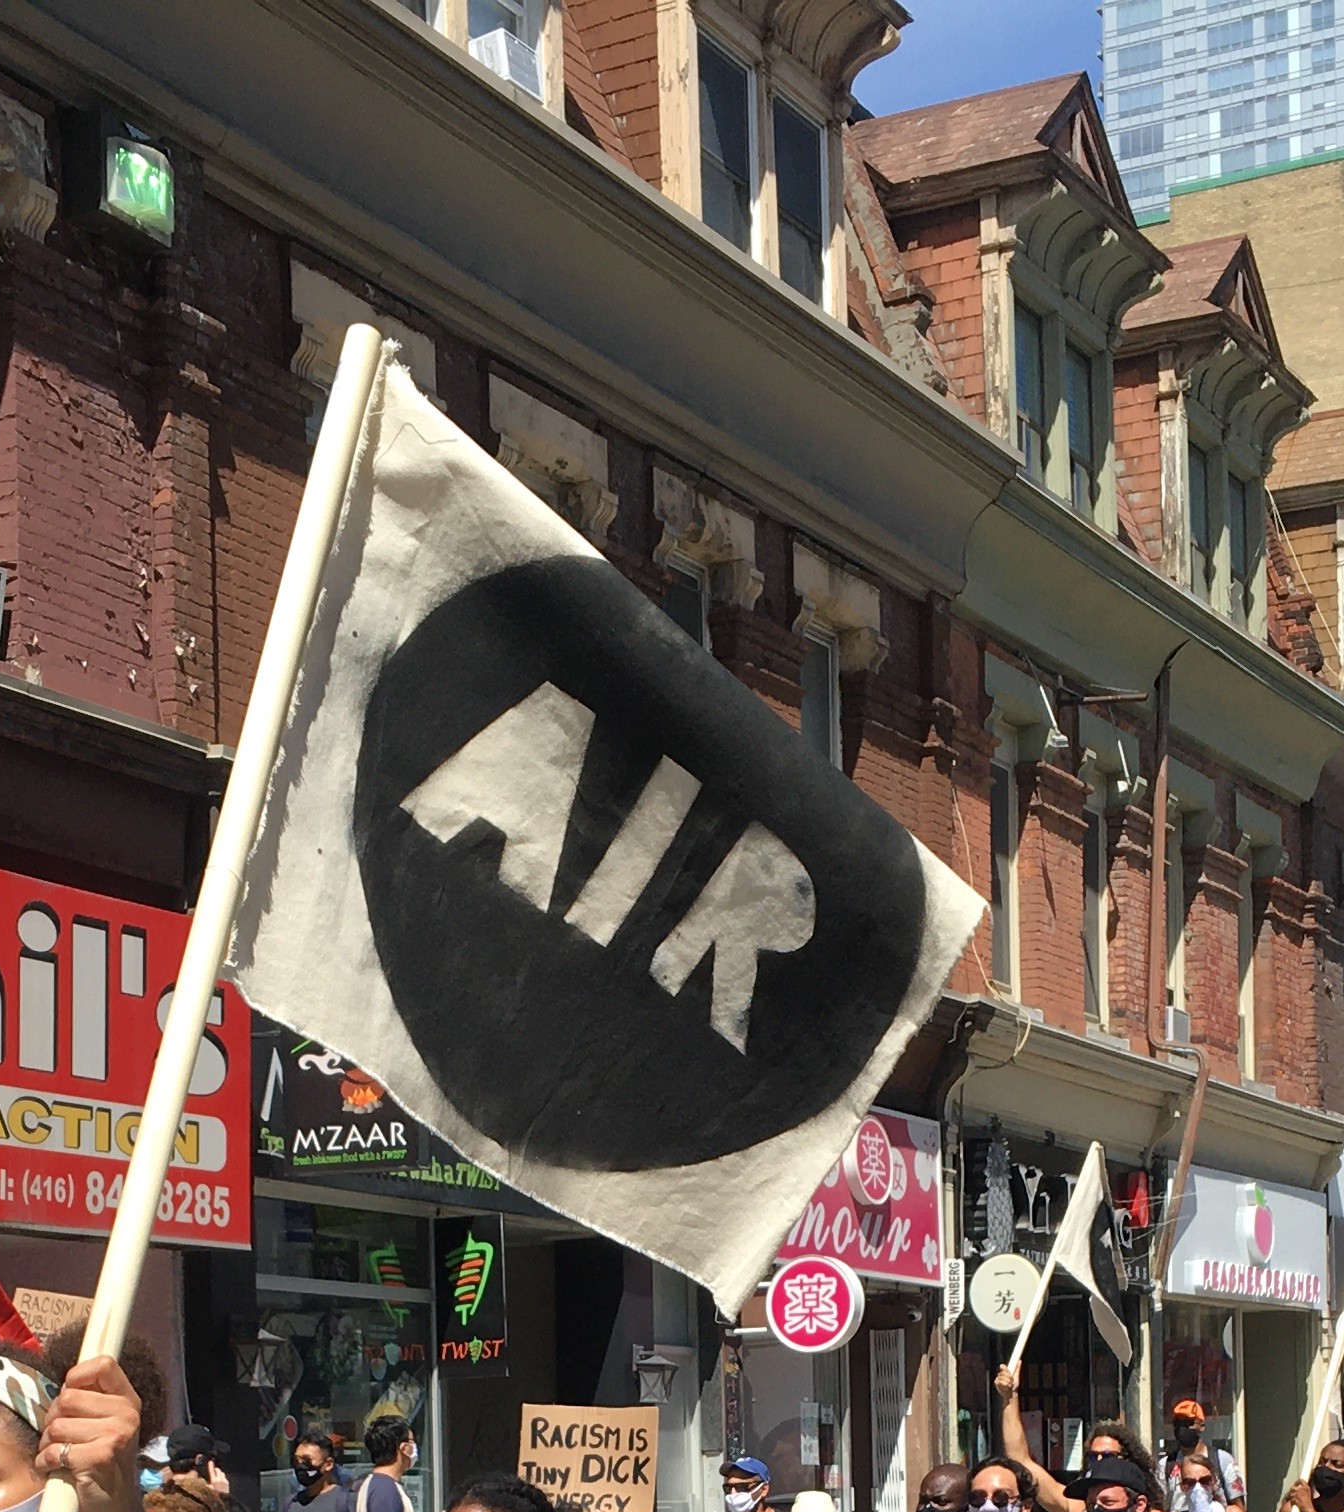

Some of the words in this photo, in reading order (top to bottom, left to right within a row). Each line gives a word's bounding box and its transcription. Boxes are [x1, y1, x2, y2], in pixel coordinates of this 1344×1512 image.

[400, 681, 817, 1055] AIR
[293, 1121, 407, 1153] M'ZAAR
[382, 1149, 407, 1161] TWIST
[22, 1169, 75, 1208] (416)
[21, 1292, 75, 1318] RACISM
[948, 1261, 960, 1315] WEINBERG
[531, 1416, 621, 1451] RACISM
[628, 1428, 648, 1453] IS
[521, 1461, 571, 1490] TINY
[580, 1454, 651, 1485] DICK
